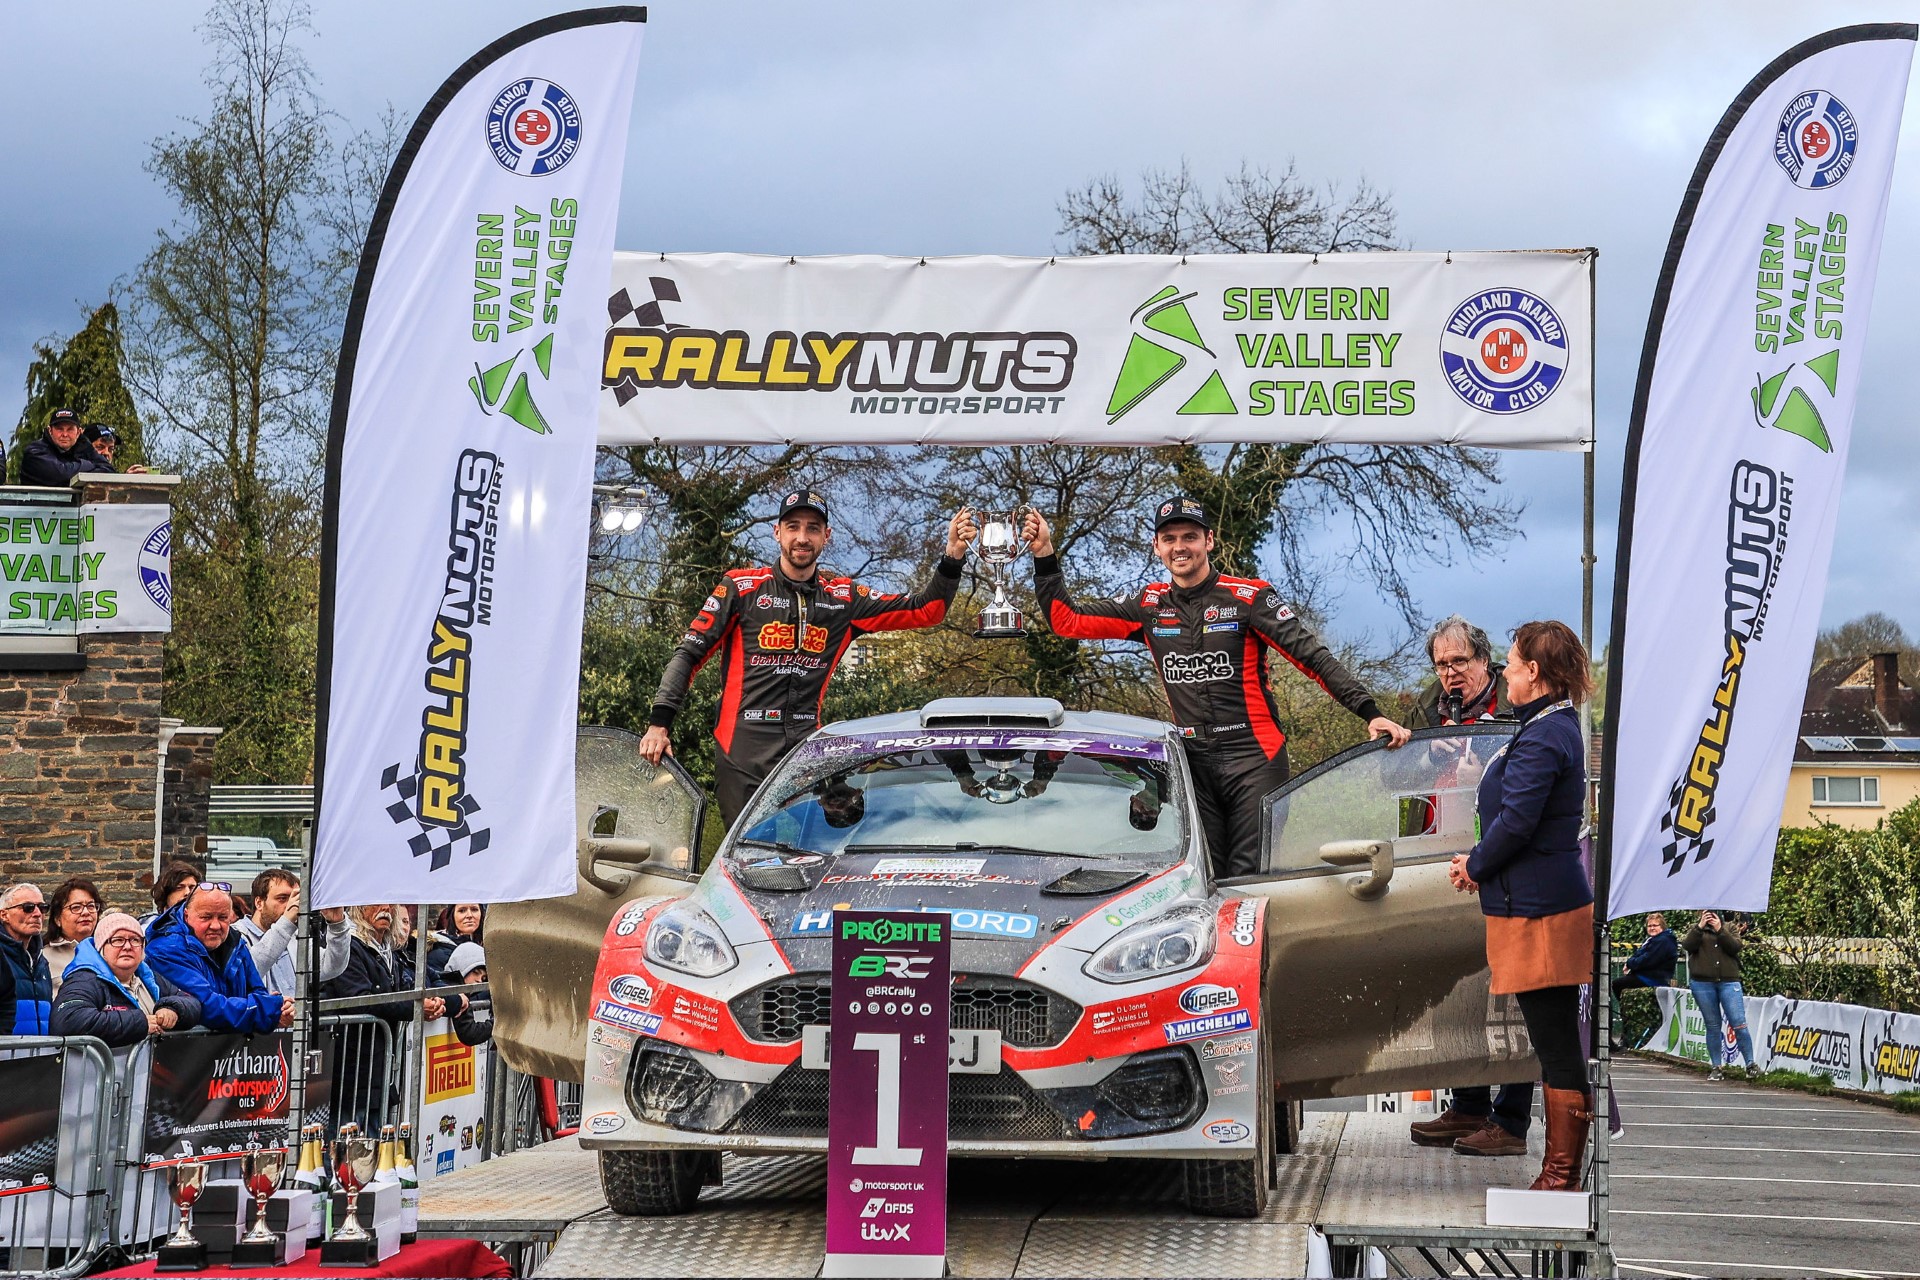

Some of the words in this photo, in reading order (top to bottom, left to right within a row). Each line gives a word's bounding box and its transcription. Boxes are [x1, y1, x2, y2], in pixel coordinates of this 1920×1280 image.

[492, 83, 527, 115] MANOR
[557, 97, 578, 127] CLUB
[1783, 95, 1813, 127] MANOR
[1836, 111, 1856, 141] CLUB
[489, 121, 518, 168] MIDLAND
[544, 138, 576, 170] MOTOR
[1777, 131, 1801, 179] MIDLAND
[1824, 152, 1852, 183] MOTOR
[507, 205, 541, 333] VALLEY
[543, 198, 577, 324] STAGES
[1815, 212, 1848, 340] STAGES
[472, 214, 503, 343] SEVERN
[1755, 223, 1785, 354] SEVERN
[1782, 217, 1819, 346] VALLEY
[1223, 287, 1390, 321] SEVERN
[1450, 293, 1511, 334] MIDLAND
[1518, 296, 1561, 342] MANOR
[1235, 333, 1402, 368] VALLEY
[1248, 380, 1416, 416] STAGES
[1450, 367, 1495, 408] MOTOR
[1509, 381, 1547, 409] CLUB
[850, 396, 1065, 415] MOTORSPORT
[477, 457, 507, 626] MOTORSPORT
[1752, 471, 1794, 642] MOTORSPORT
[9, 590, 118, 621] STAES
[1236, 588, 1254, 599] OMP
[1164, 651, 1229, 669] demon
[1164, 665, 1233, 682] tweeks
[744, 711, 762, 720] OMP
[875, 735, 995, 749] PROBITE
[842, 918, 942, 944] PROBITE
[952, 911, 1031, 934] ORD
[849, 955, 934, 979] BRC
[866, 985, 916, 998] @BRCrally
[604, 1005, 661, 1029] MICHELIN
[1117, 1013, 1137, 1022] Wales
[1129, 1003, 1147, 1011] Jones
[1176, 1011, 1246, 1035] MICHELIN
[213, 1046, 279, 1078] witham
[428, 1042, 473, 1095] PIRELLI
[208, 1078, 278, 1101] Motorsport
[239, 1097, 255, 1108] OILS
[851, 1032, 924, 1166] 1
[913, 1033, 926, 1044] st
[172, 1123, 218, 1135] Manufacturers
[224, 1119, 252, 1128] Distributors
[253, 1117, 259, 1126] of
[592, 1117, 618, 1127] RSC
[1211, 1126, 1240, 1136] RSC
[864, 1181, 912, 1191] motorsport
[913, 1182, 924, 1191] UK
[884, 1203, 914, 1214] DFDS
[860, 1222, 911, 1241] itvX
